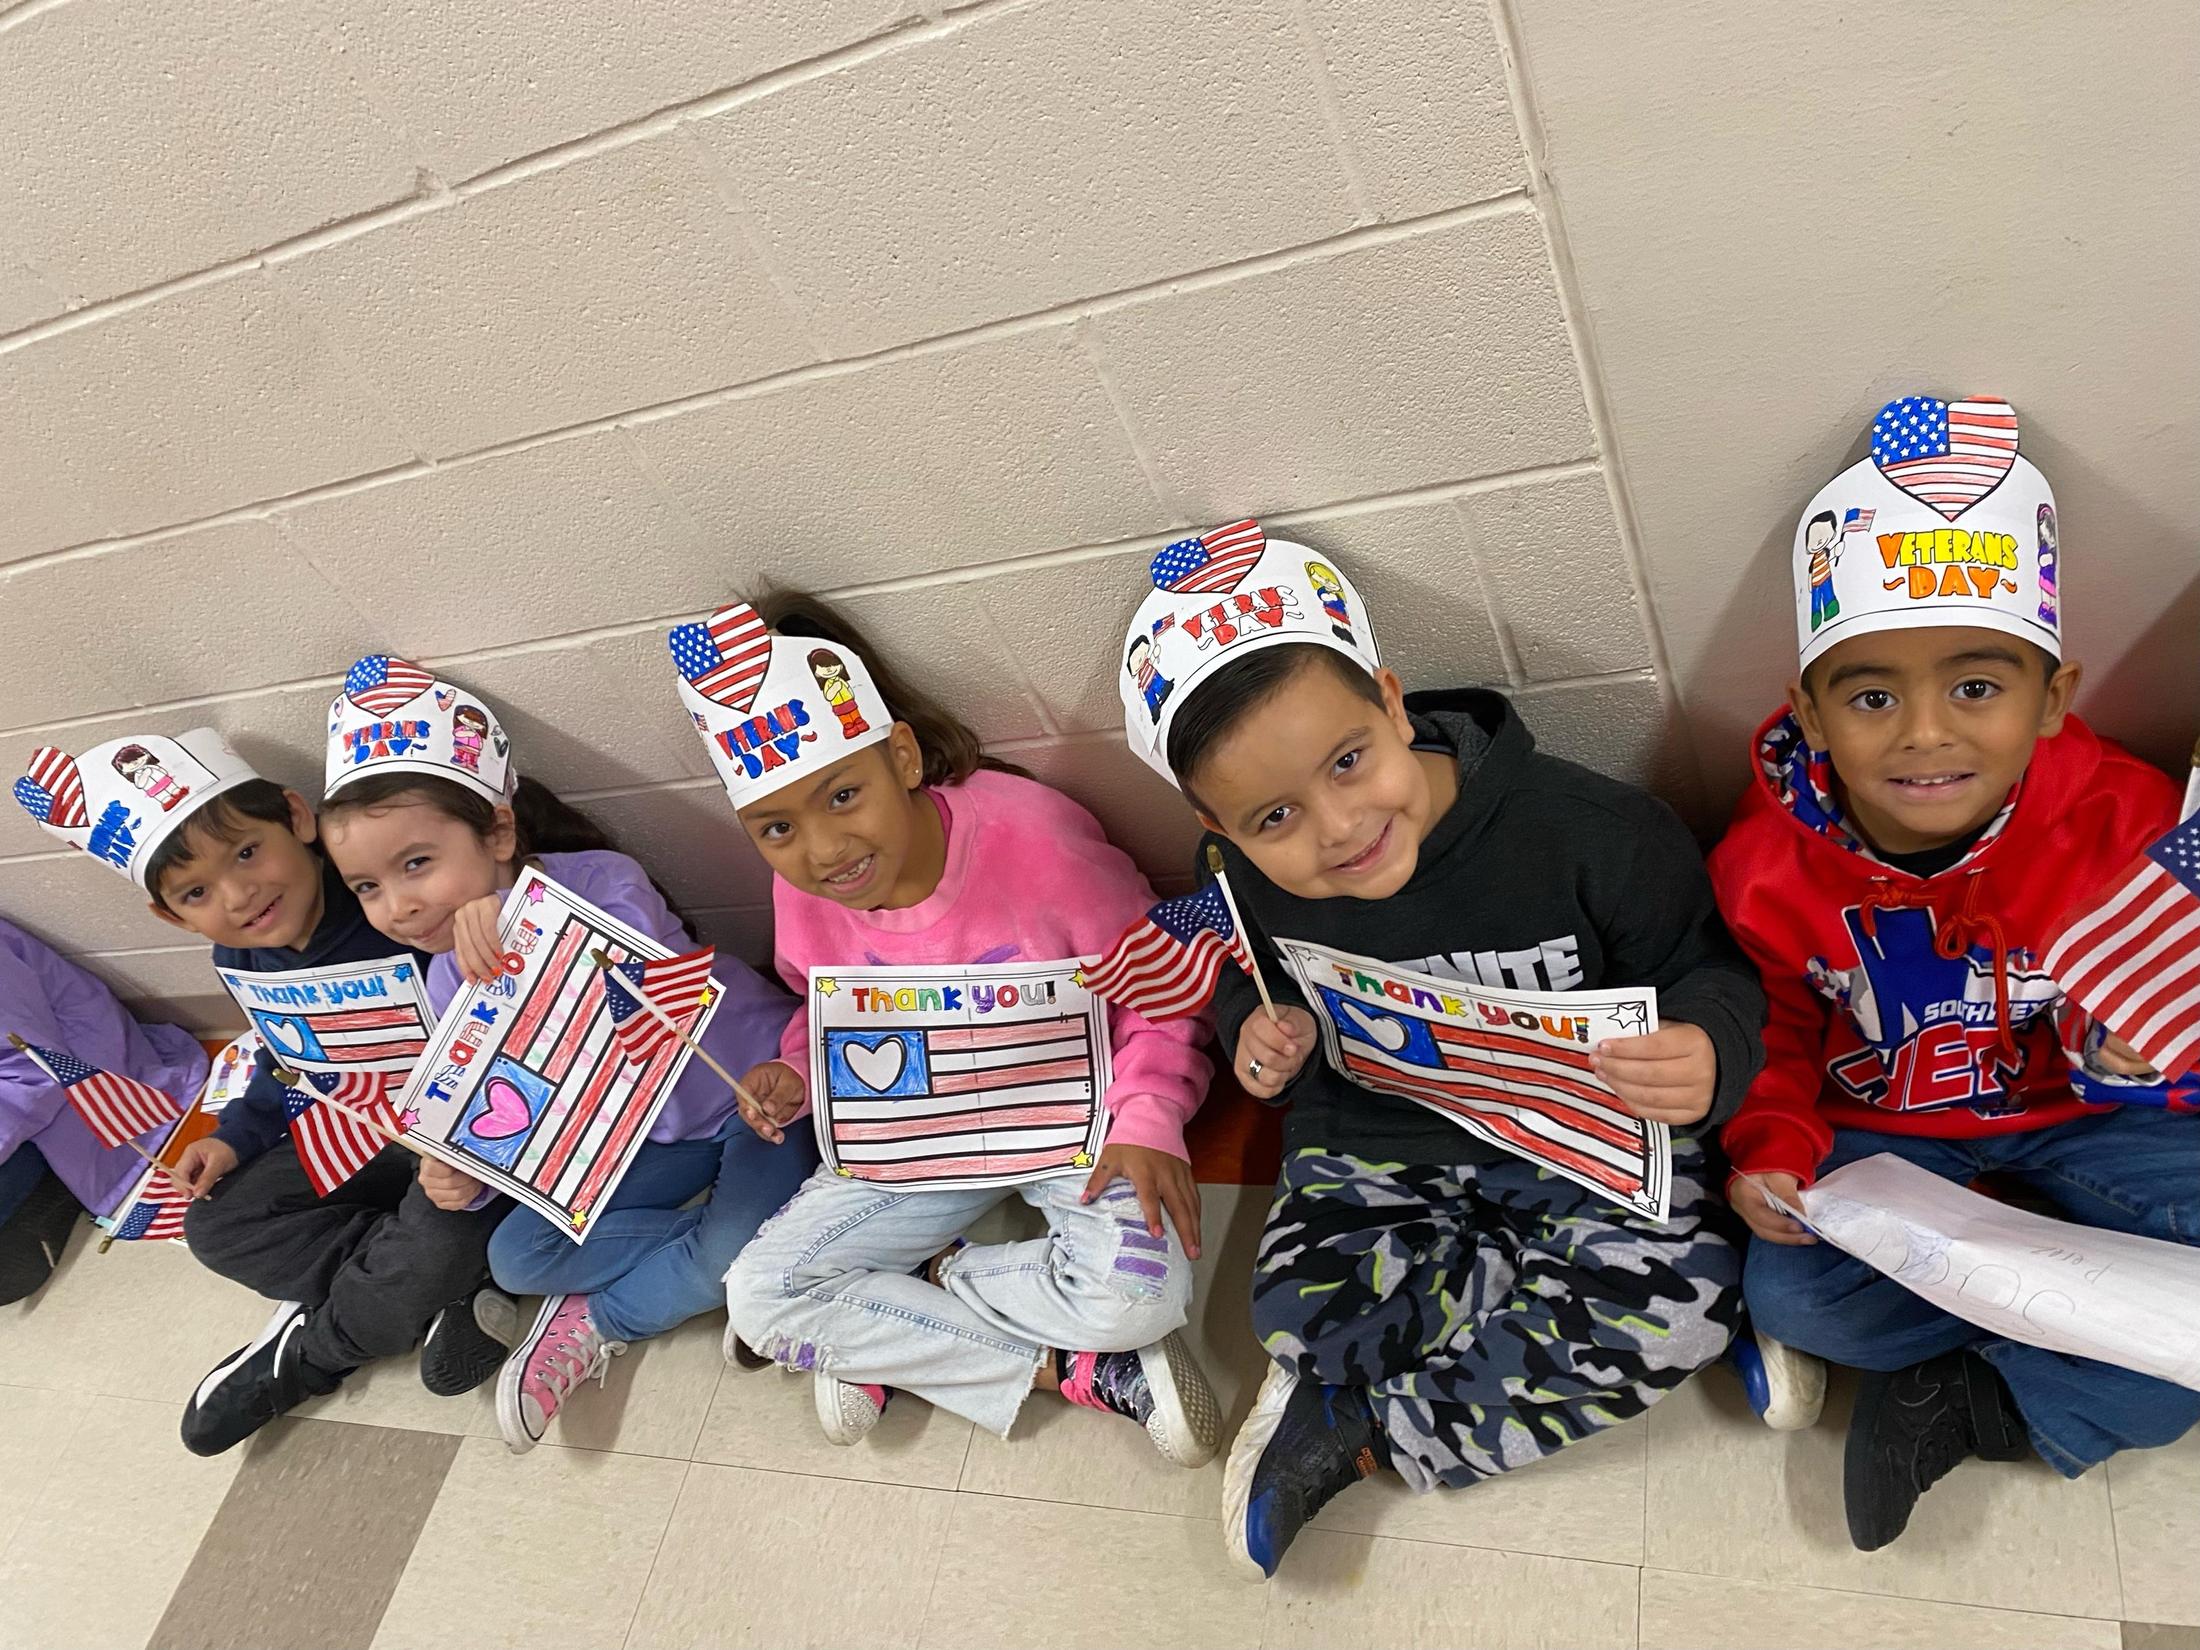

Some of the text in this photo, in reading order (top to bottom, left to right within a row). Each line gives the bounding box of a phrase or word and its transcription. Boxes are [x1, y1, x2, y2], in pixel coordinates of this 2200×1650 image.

[1877, 528, 2018, 570] VETERANS
[1908, 565, 2001, 599] DAY
[1181, 585, 1299, 639] VETERANS
[1212, 607, 1284, 646] DAY
[354, 738, 412, 764] DAY
[715, 699, 811, 760] VETERANS
[741, 731, 800, 779] DAY
[852, 980, 1057, 1014] Thank you!
[1332, 963, 1590, 1044] Thank you!
[425, 1000, 499, 1103] Thank
